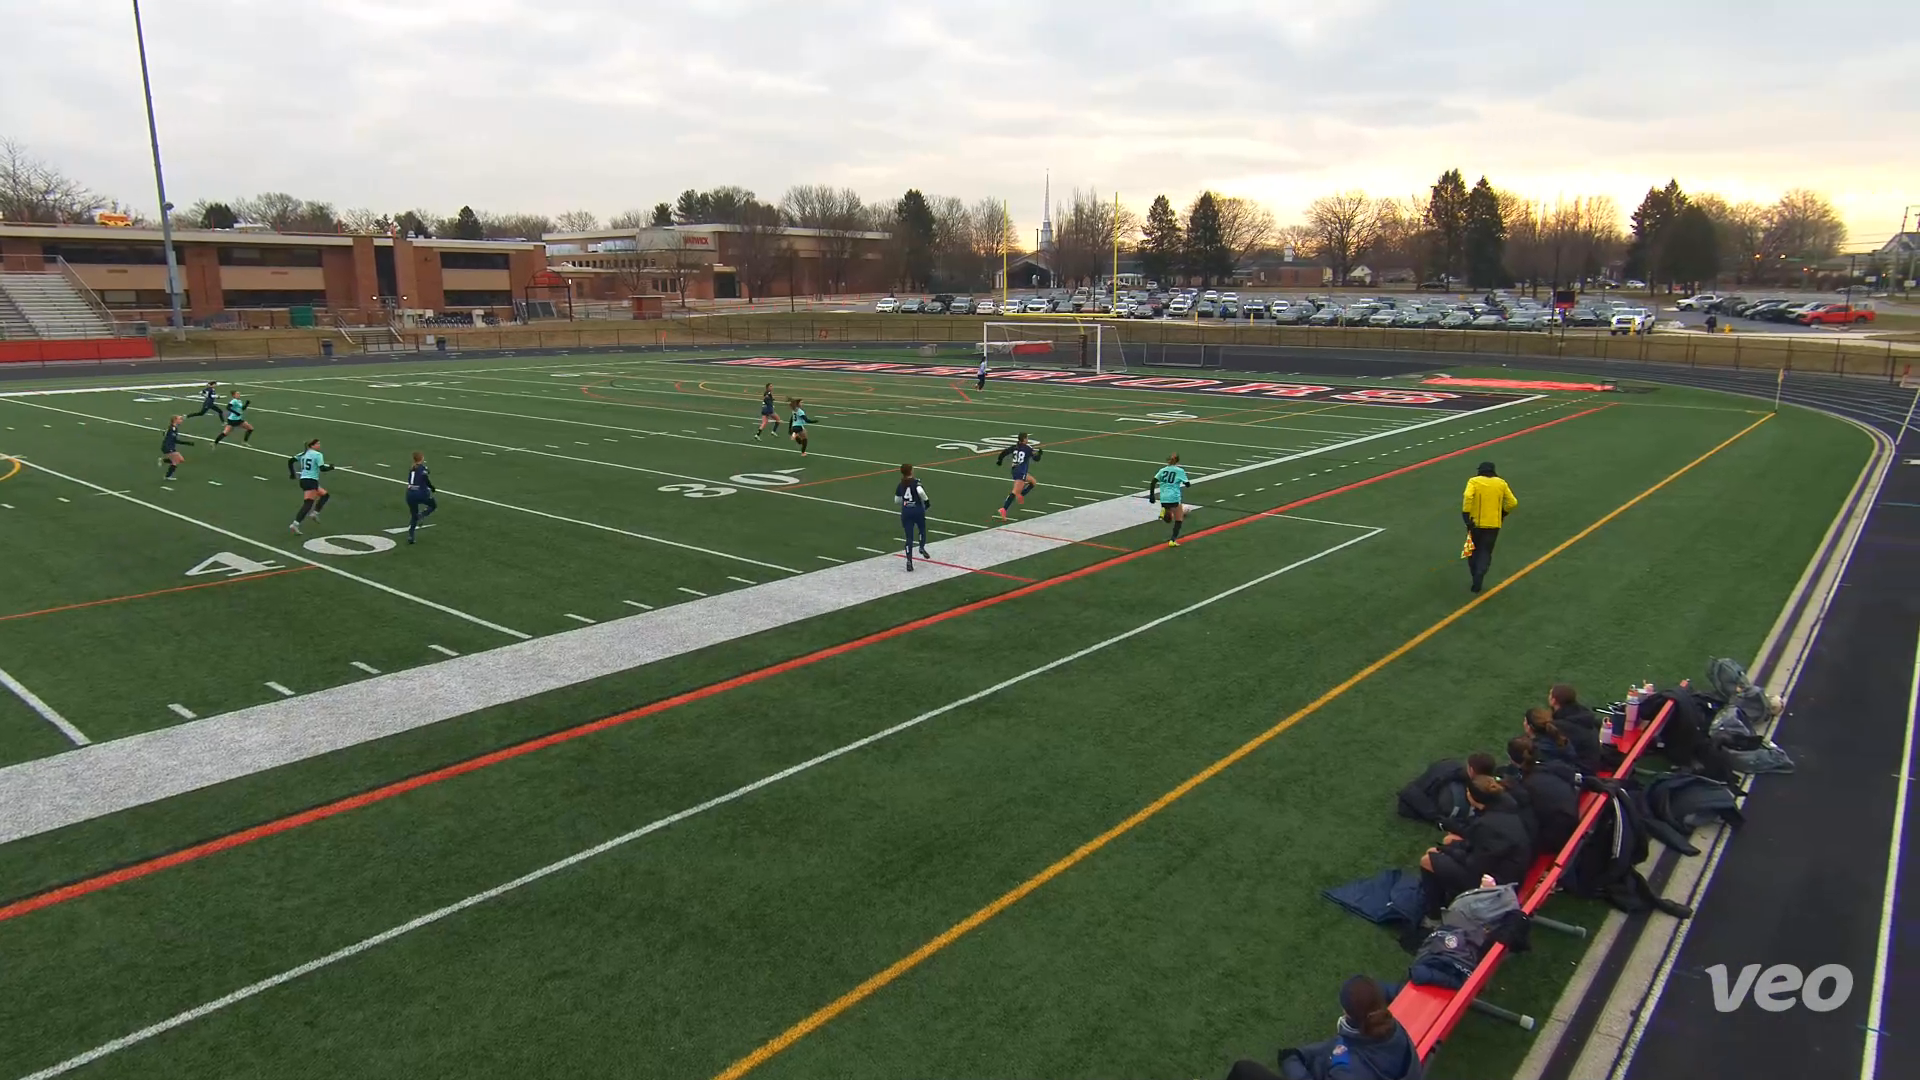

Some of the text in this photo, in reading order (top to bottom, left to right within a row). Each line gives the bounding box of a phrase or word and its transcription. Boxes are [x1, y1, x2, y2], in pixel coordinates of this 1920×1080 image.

[709, 357, 1463, 404] WARRIORS
[1114, 412, 1199, 425] 10
[935, 436, 1041, 454] 20
[301, 459, 312, 471] 15
[1012, 450, 1026, 464] 38
[657, 473, 801, 498] 30
[1161, 471, 1177, 484] 20
[903, 486, 913, 502] 4
[184, 534, 398, 577] 40
